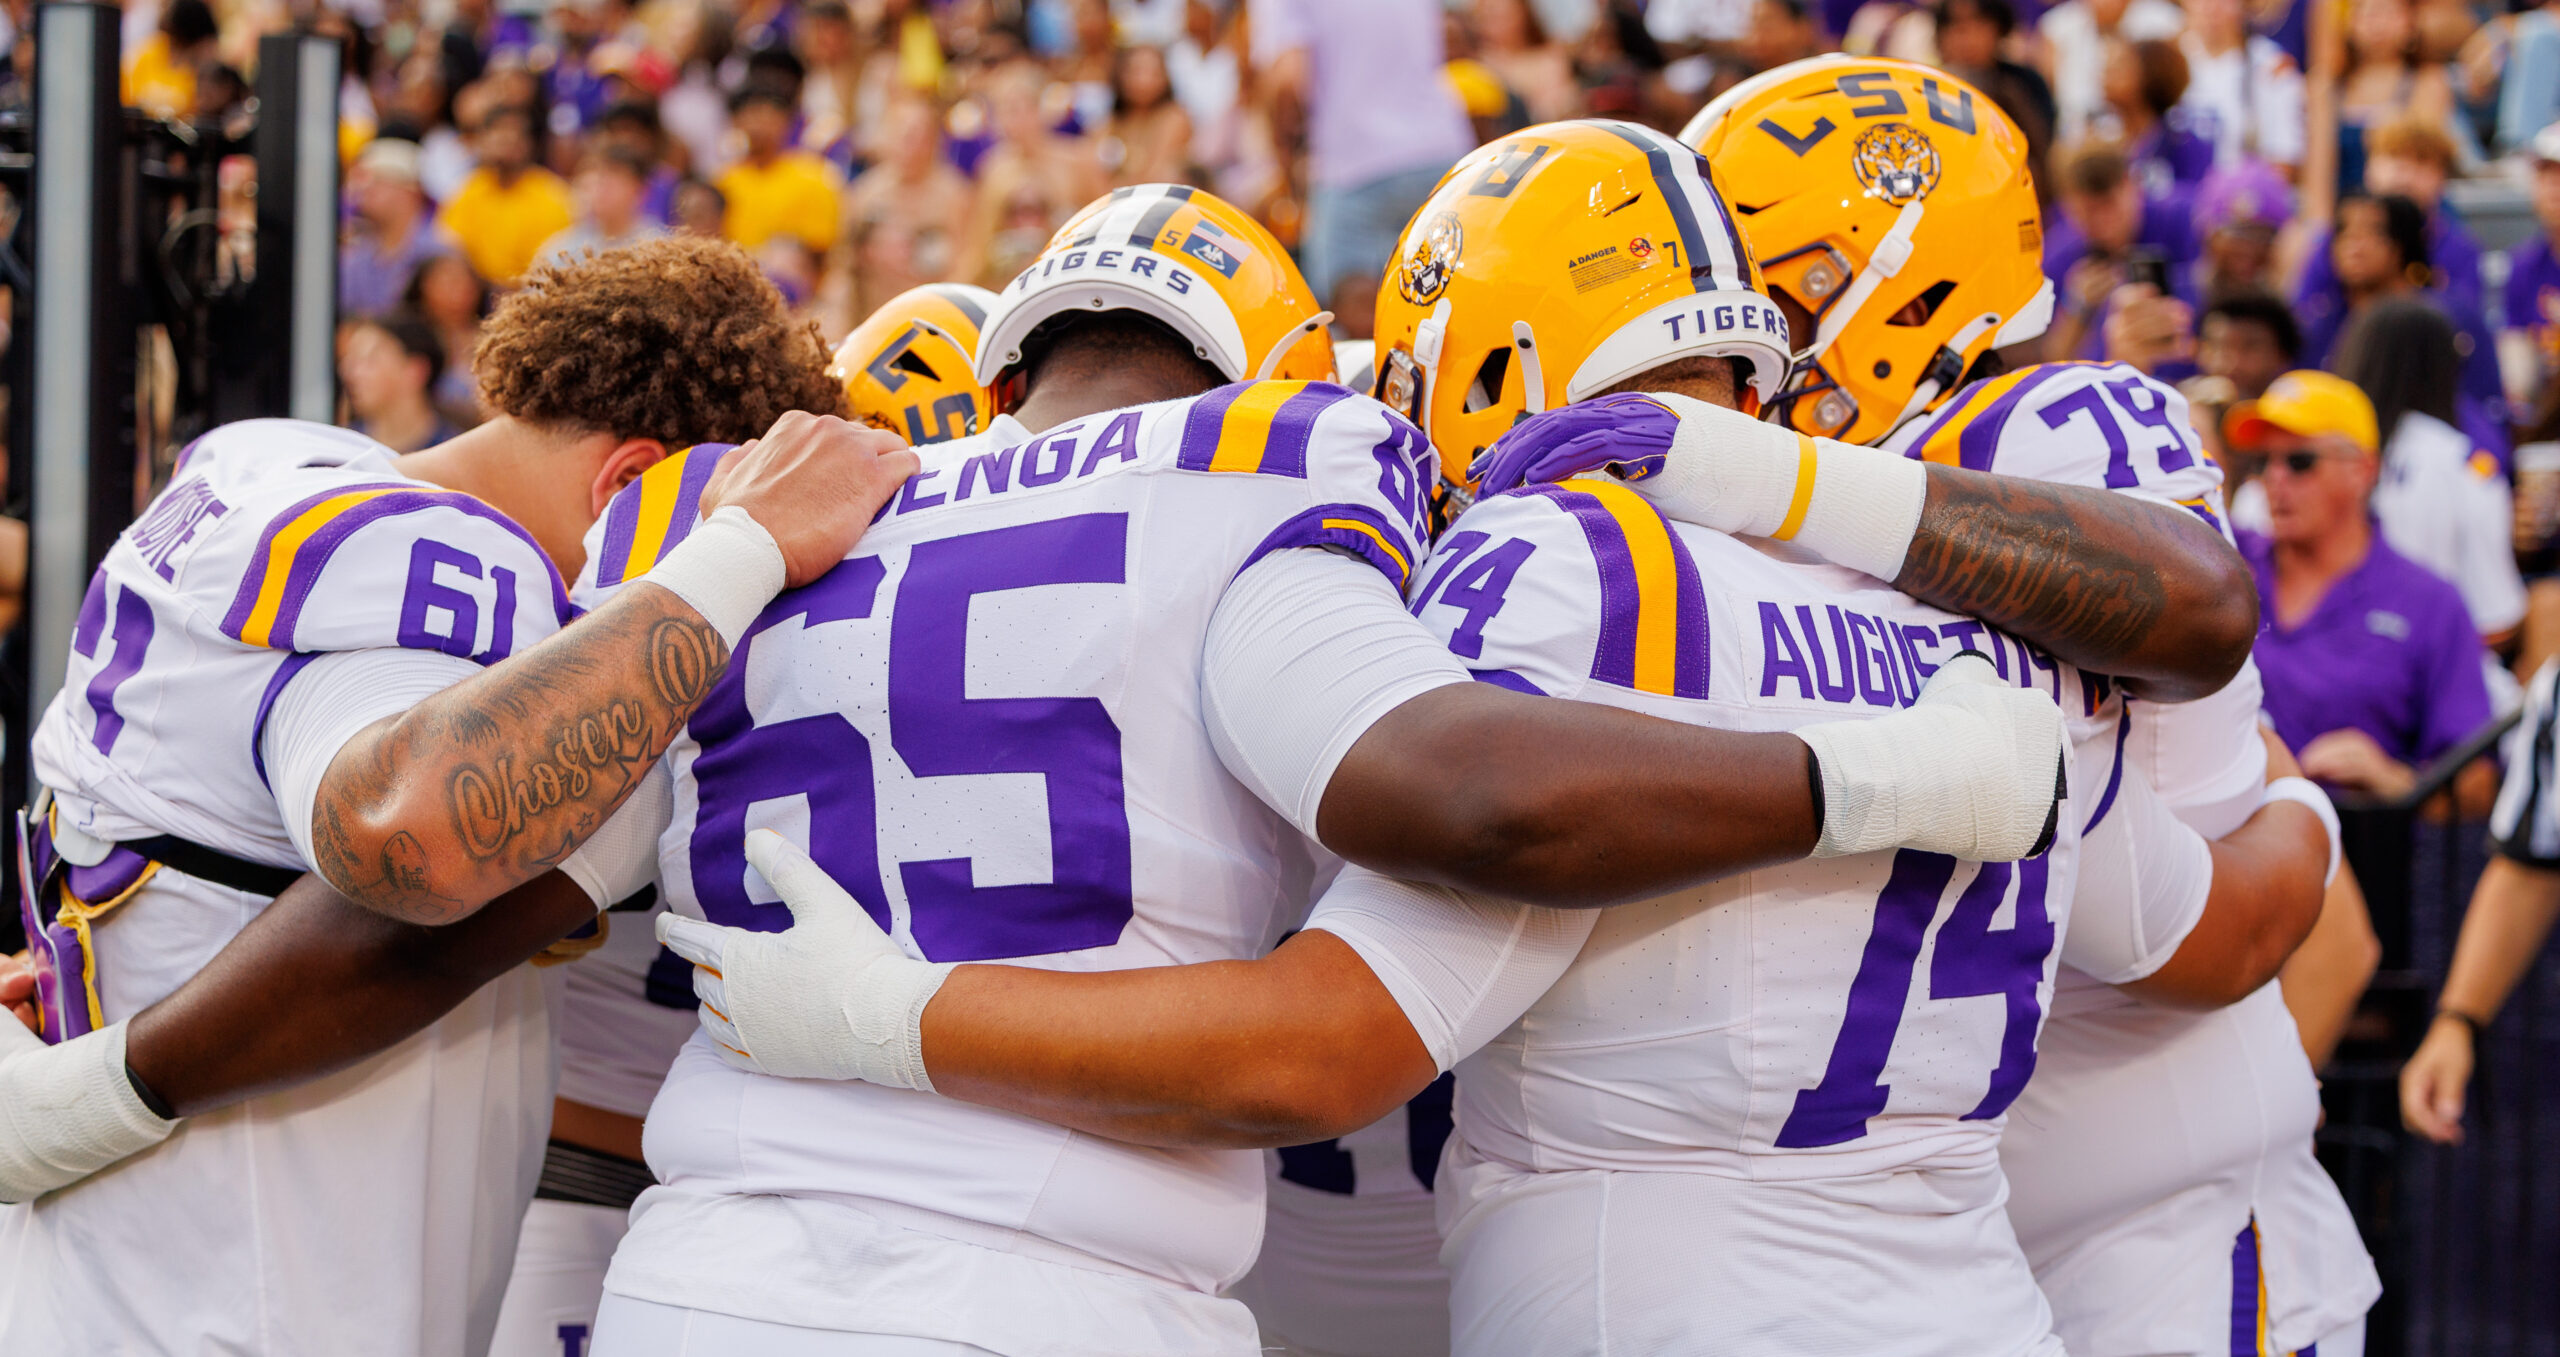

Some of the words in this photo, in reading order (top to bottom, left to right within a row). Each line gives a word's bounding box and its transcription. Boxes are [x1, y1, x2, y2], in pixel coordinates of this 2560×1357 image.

[1757, 72, 1977, 158] LSU
[1018, 250, 1193, 295] TIGERS
[1577, 246, 1617, 265] DANGER
[1662, 241, 1681, 268] 7
[1663, 305, 1788, 343] TIGERS
[866, 327, 978, 448] LS
[2036, 376, 2195, 490] 79
[868, 410, 1143, 526] ENGA
[396, 537, 517, 668] 61
[1406, 530, 1537, 660] 74
[449, 698, 644, 862] Chosen
[688, 511, 1134, 963] 65
